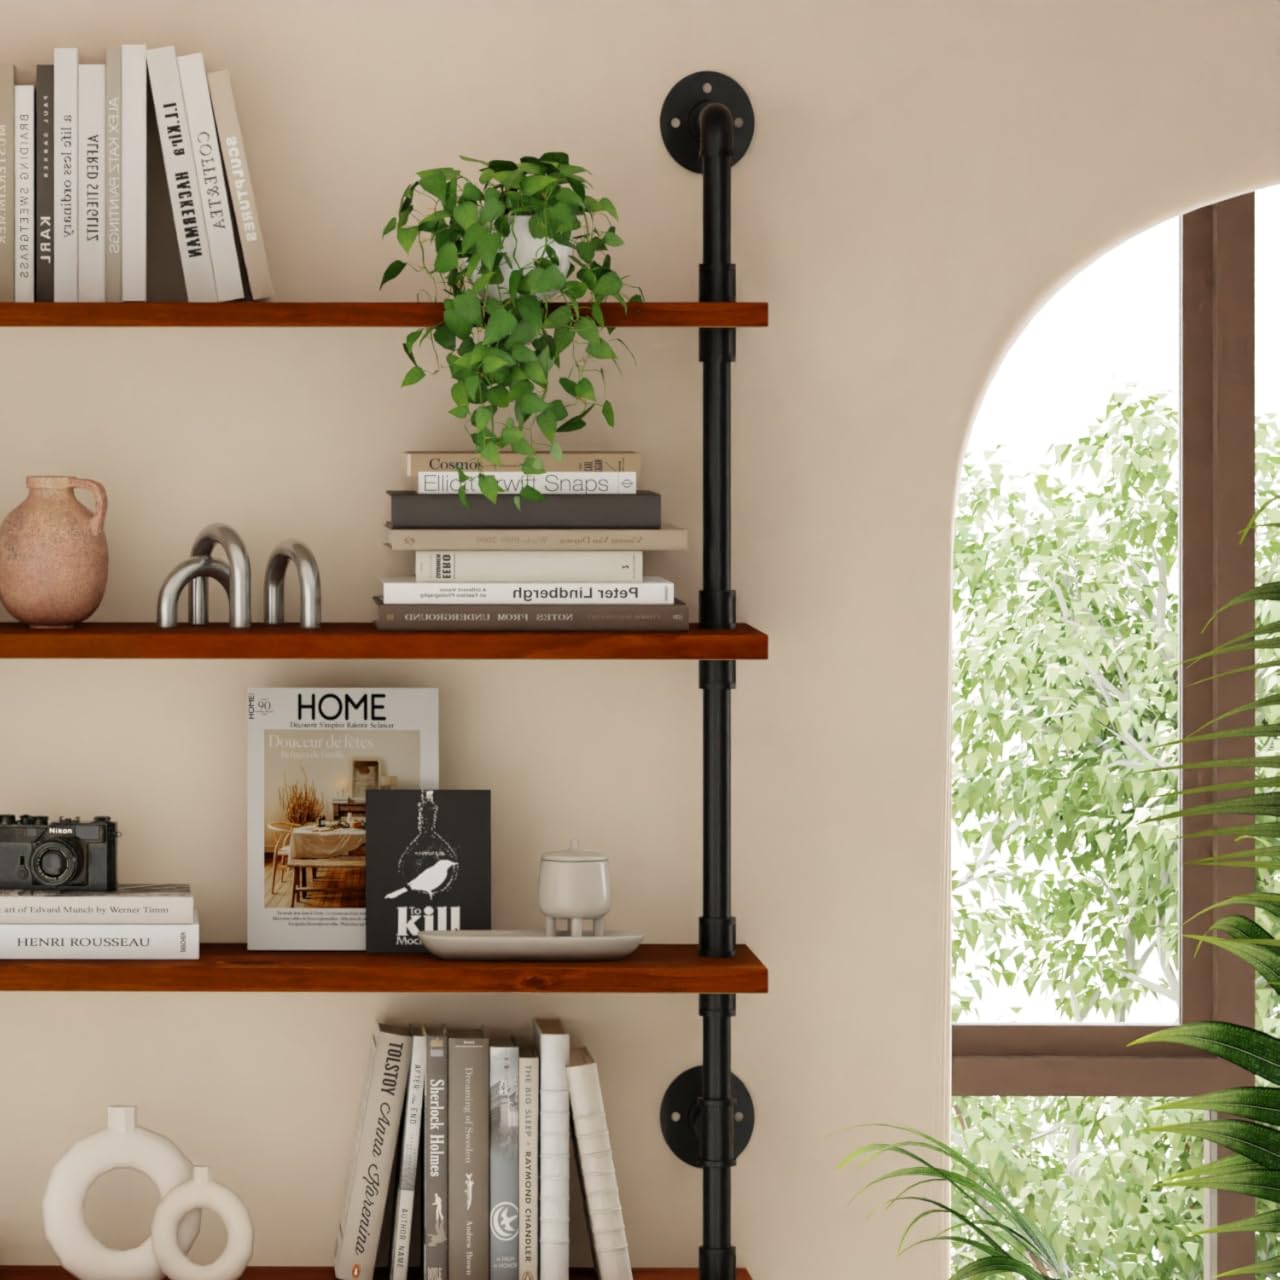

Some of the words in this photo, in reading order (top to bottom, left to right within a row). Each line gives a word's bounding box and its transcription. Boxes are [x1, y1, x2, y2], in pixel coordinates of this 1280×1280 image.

[544, 474, 609, 494] Snaps
[297, 693, 387, 720] HOME
[268, 735, 324, 750] Douceur
[48, 826, 73, 835] Nikon
[396, 906, 461, 936] kill
[408, 906, 422, 916] To
[17, 937, 65, 947] HENRI
[70, 937, 151, 947] ROUSSEAU
[380, 1042, 404, 1096] TOLSTOY
[412, 1063, 422, 1090] AFTER
[524, 1064, 532, 1083] THE
[428, 1079, 445, 1130] Sherlock
[464, 1067, 474, 1113] Dreaming
[524, 1086, 532, 1105] BIG
[371, 1100, 392, 1158] Anna
[409, 1107, 417, 1125] END
[524, 1108, 532, 1138] SLEEP
[429, 1134, 445, 1177] Holmes
[464, 1126, 474, 1163] Sweden
[524, 1151, 532, 1205] RAYMOND
[353, 1163, 380, 1257] Karenina
[399, 1208, 409, 1240] AUTHOR
[524, 1207, 532, 1263] CHANDLER
